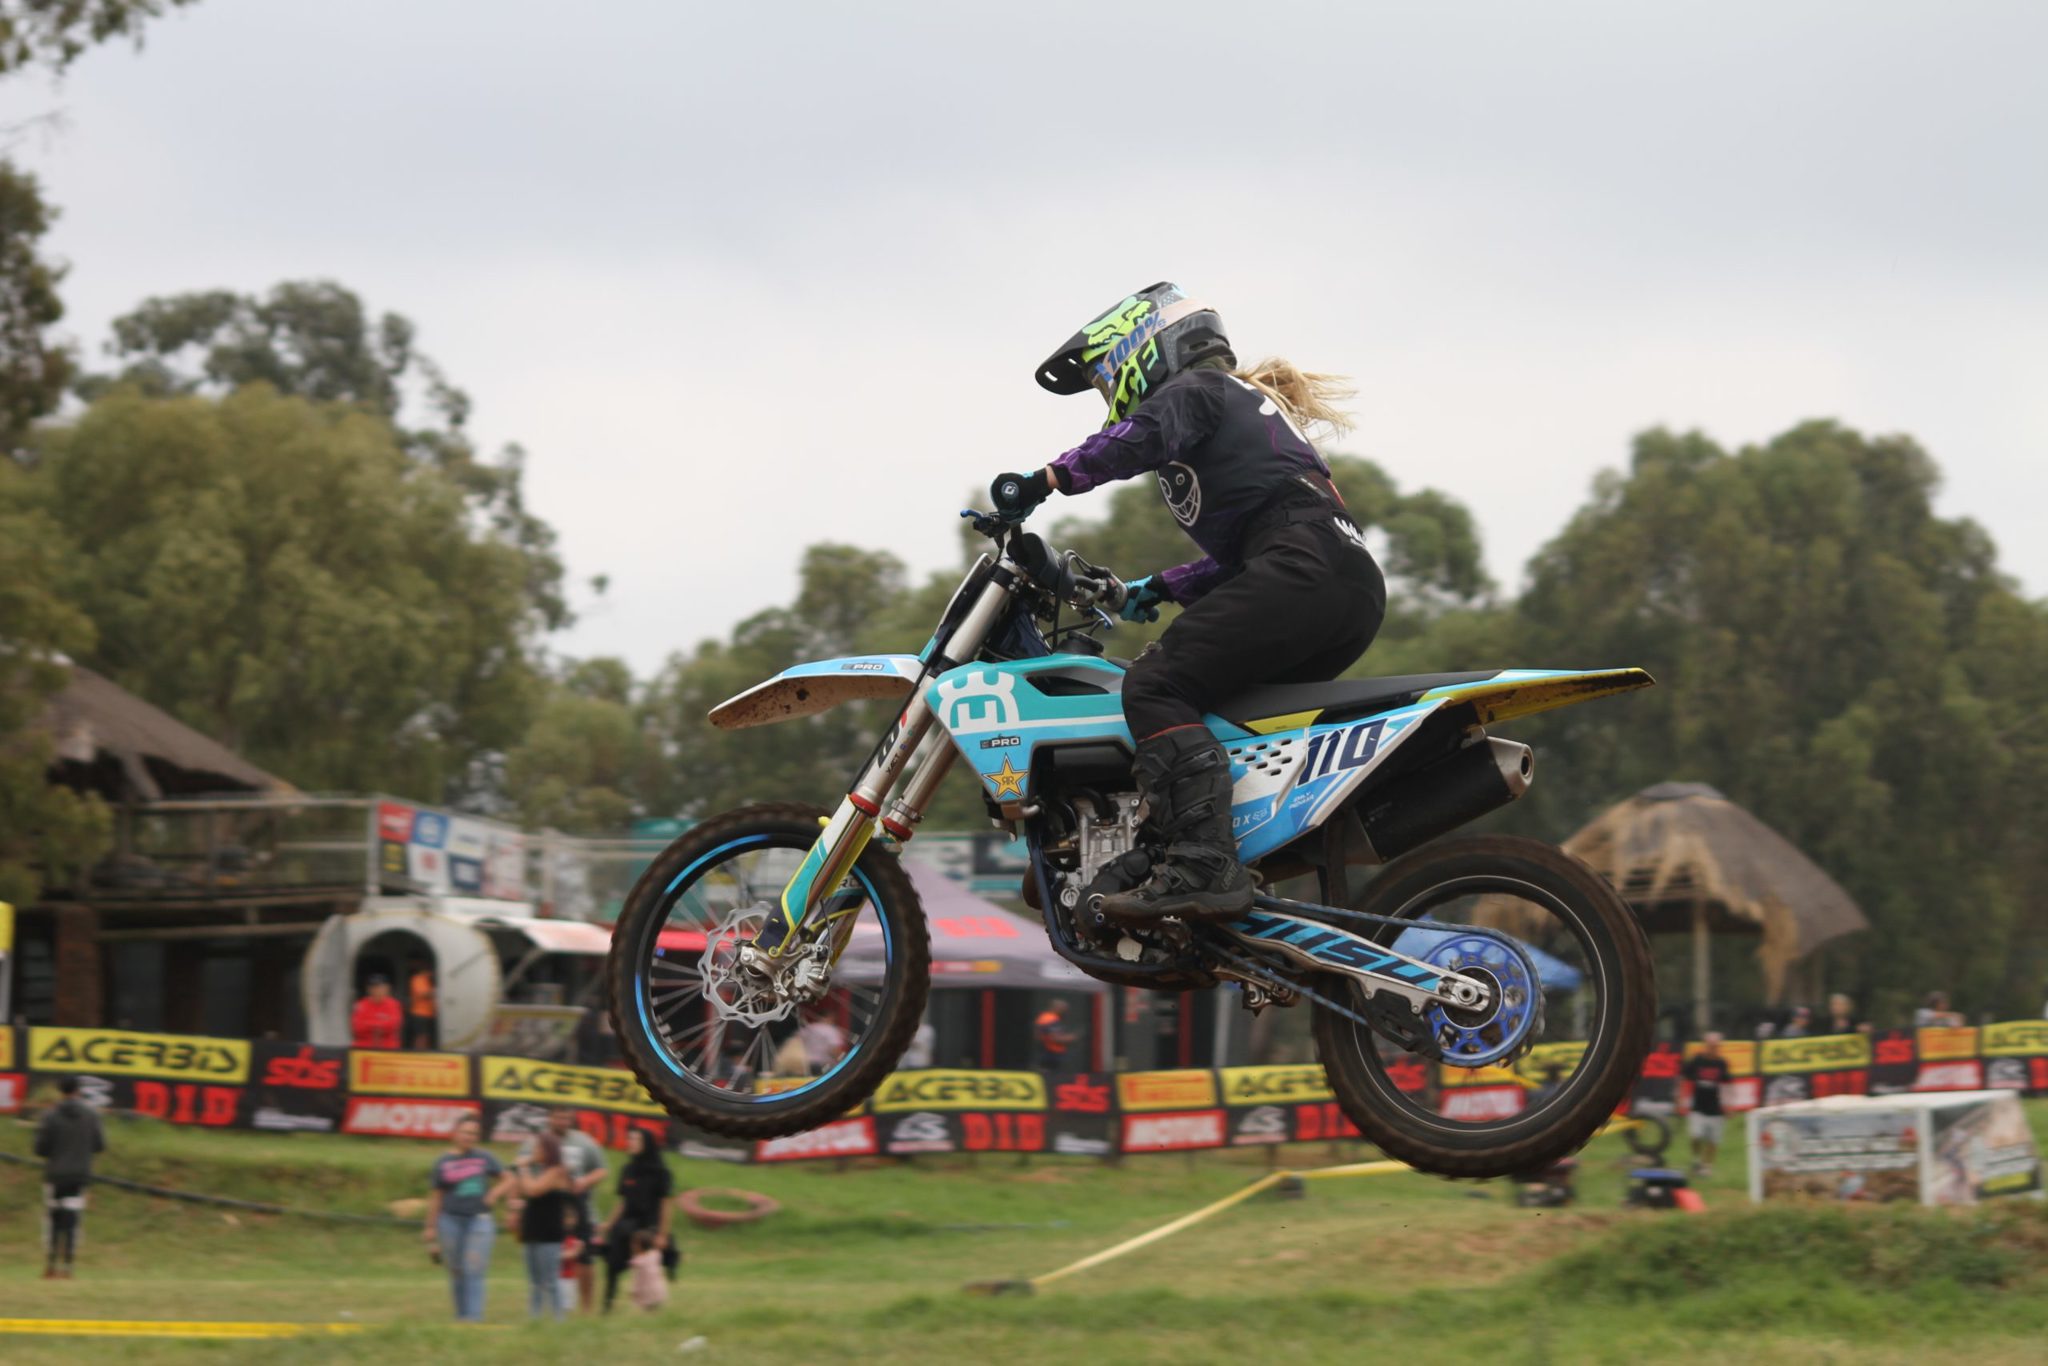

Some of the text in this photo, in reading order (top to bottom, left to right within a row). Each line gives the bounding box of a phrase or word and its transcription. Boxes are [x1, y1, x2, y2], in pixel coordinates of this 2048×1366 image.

[1108, 312, 1165, 371] 100%
[1298, 718, 1388, 785] 110
[133, 1080, 241, 1125] DID
